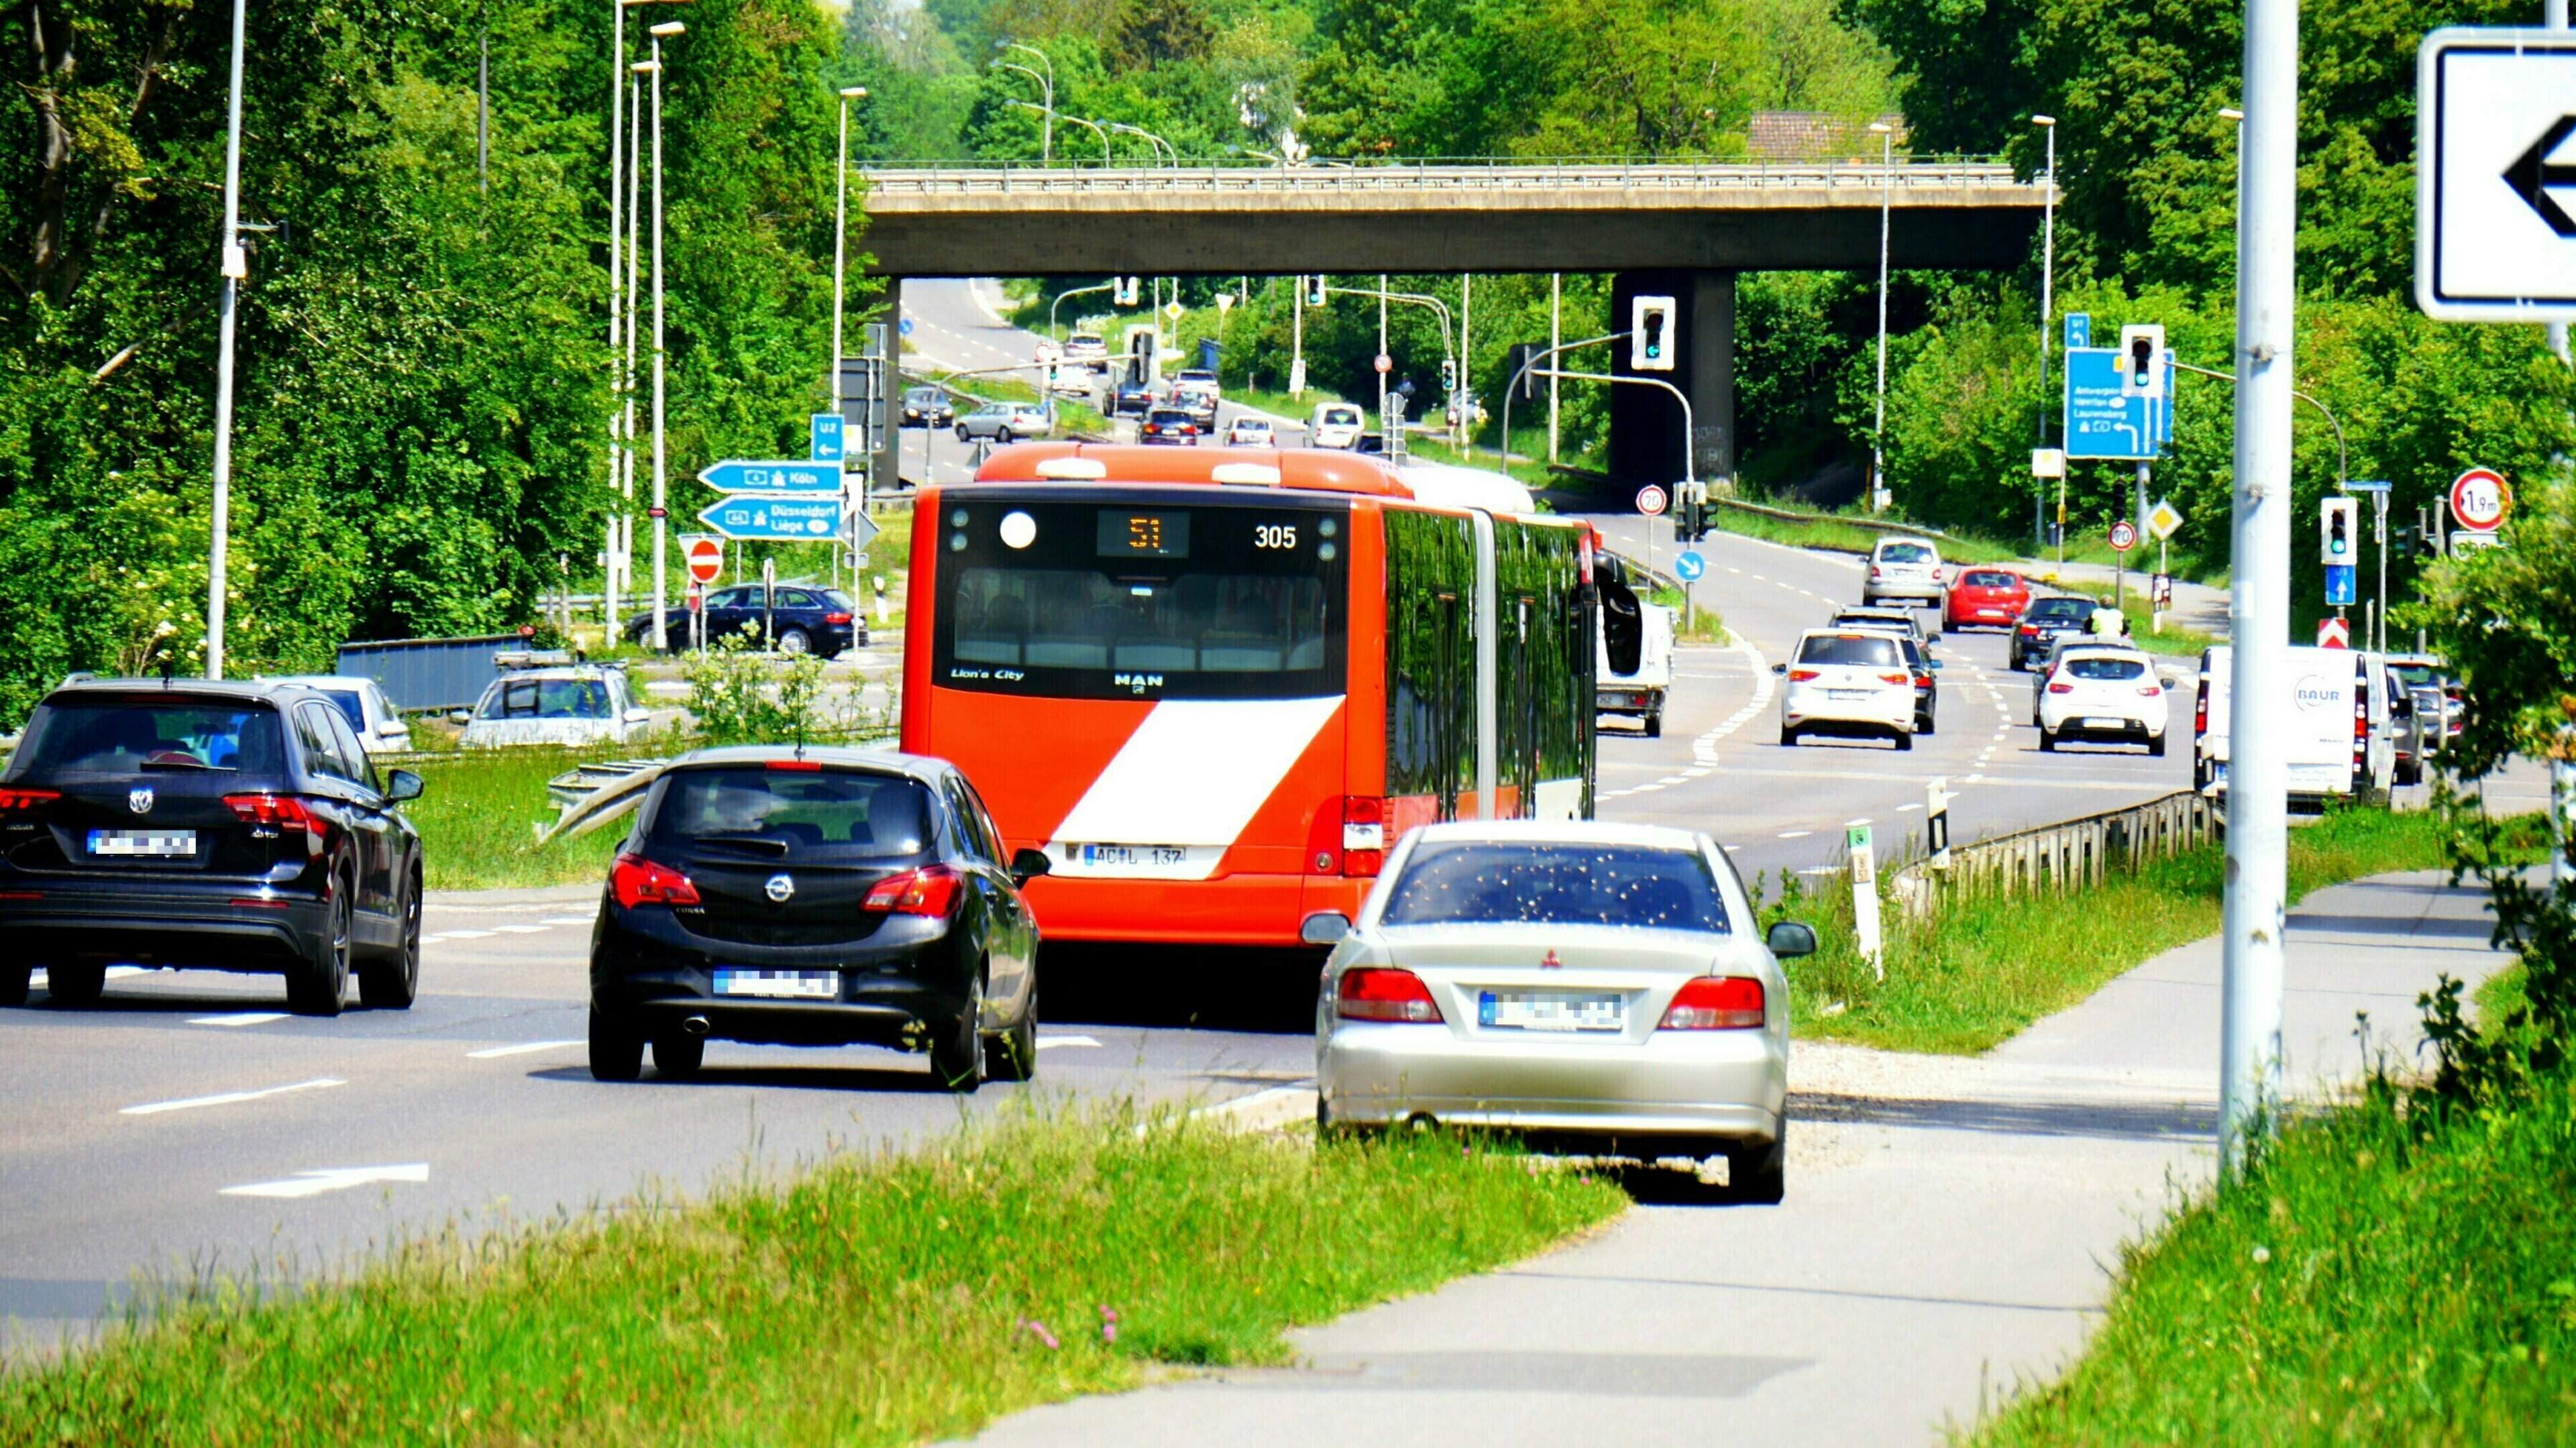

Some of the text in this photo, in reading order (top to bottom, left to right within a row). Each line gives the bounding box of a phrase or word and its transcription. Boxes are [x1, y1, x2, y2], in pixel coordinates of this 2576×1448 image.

[820, 423, 837, 434] U2
[790, 471, 818, 484] Köln
[1646, 495, 1659, 507] 70
[771, 504, 837, 516] Düsseldorf
[771, 519, 804, 533] Liège
[1130, 518, 1159, 548] 51
[1254, 525, 1296, 549] 305
[2114, 530, 2130, 543] 70
[951, 669, 1025, 681] Lion's City
[1114, 673, 1164, 687] MAN
[2298, 689, 2340, 701] BAUR
[1097, 847, 1181, 866] AC L 137
